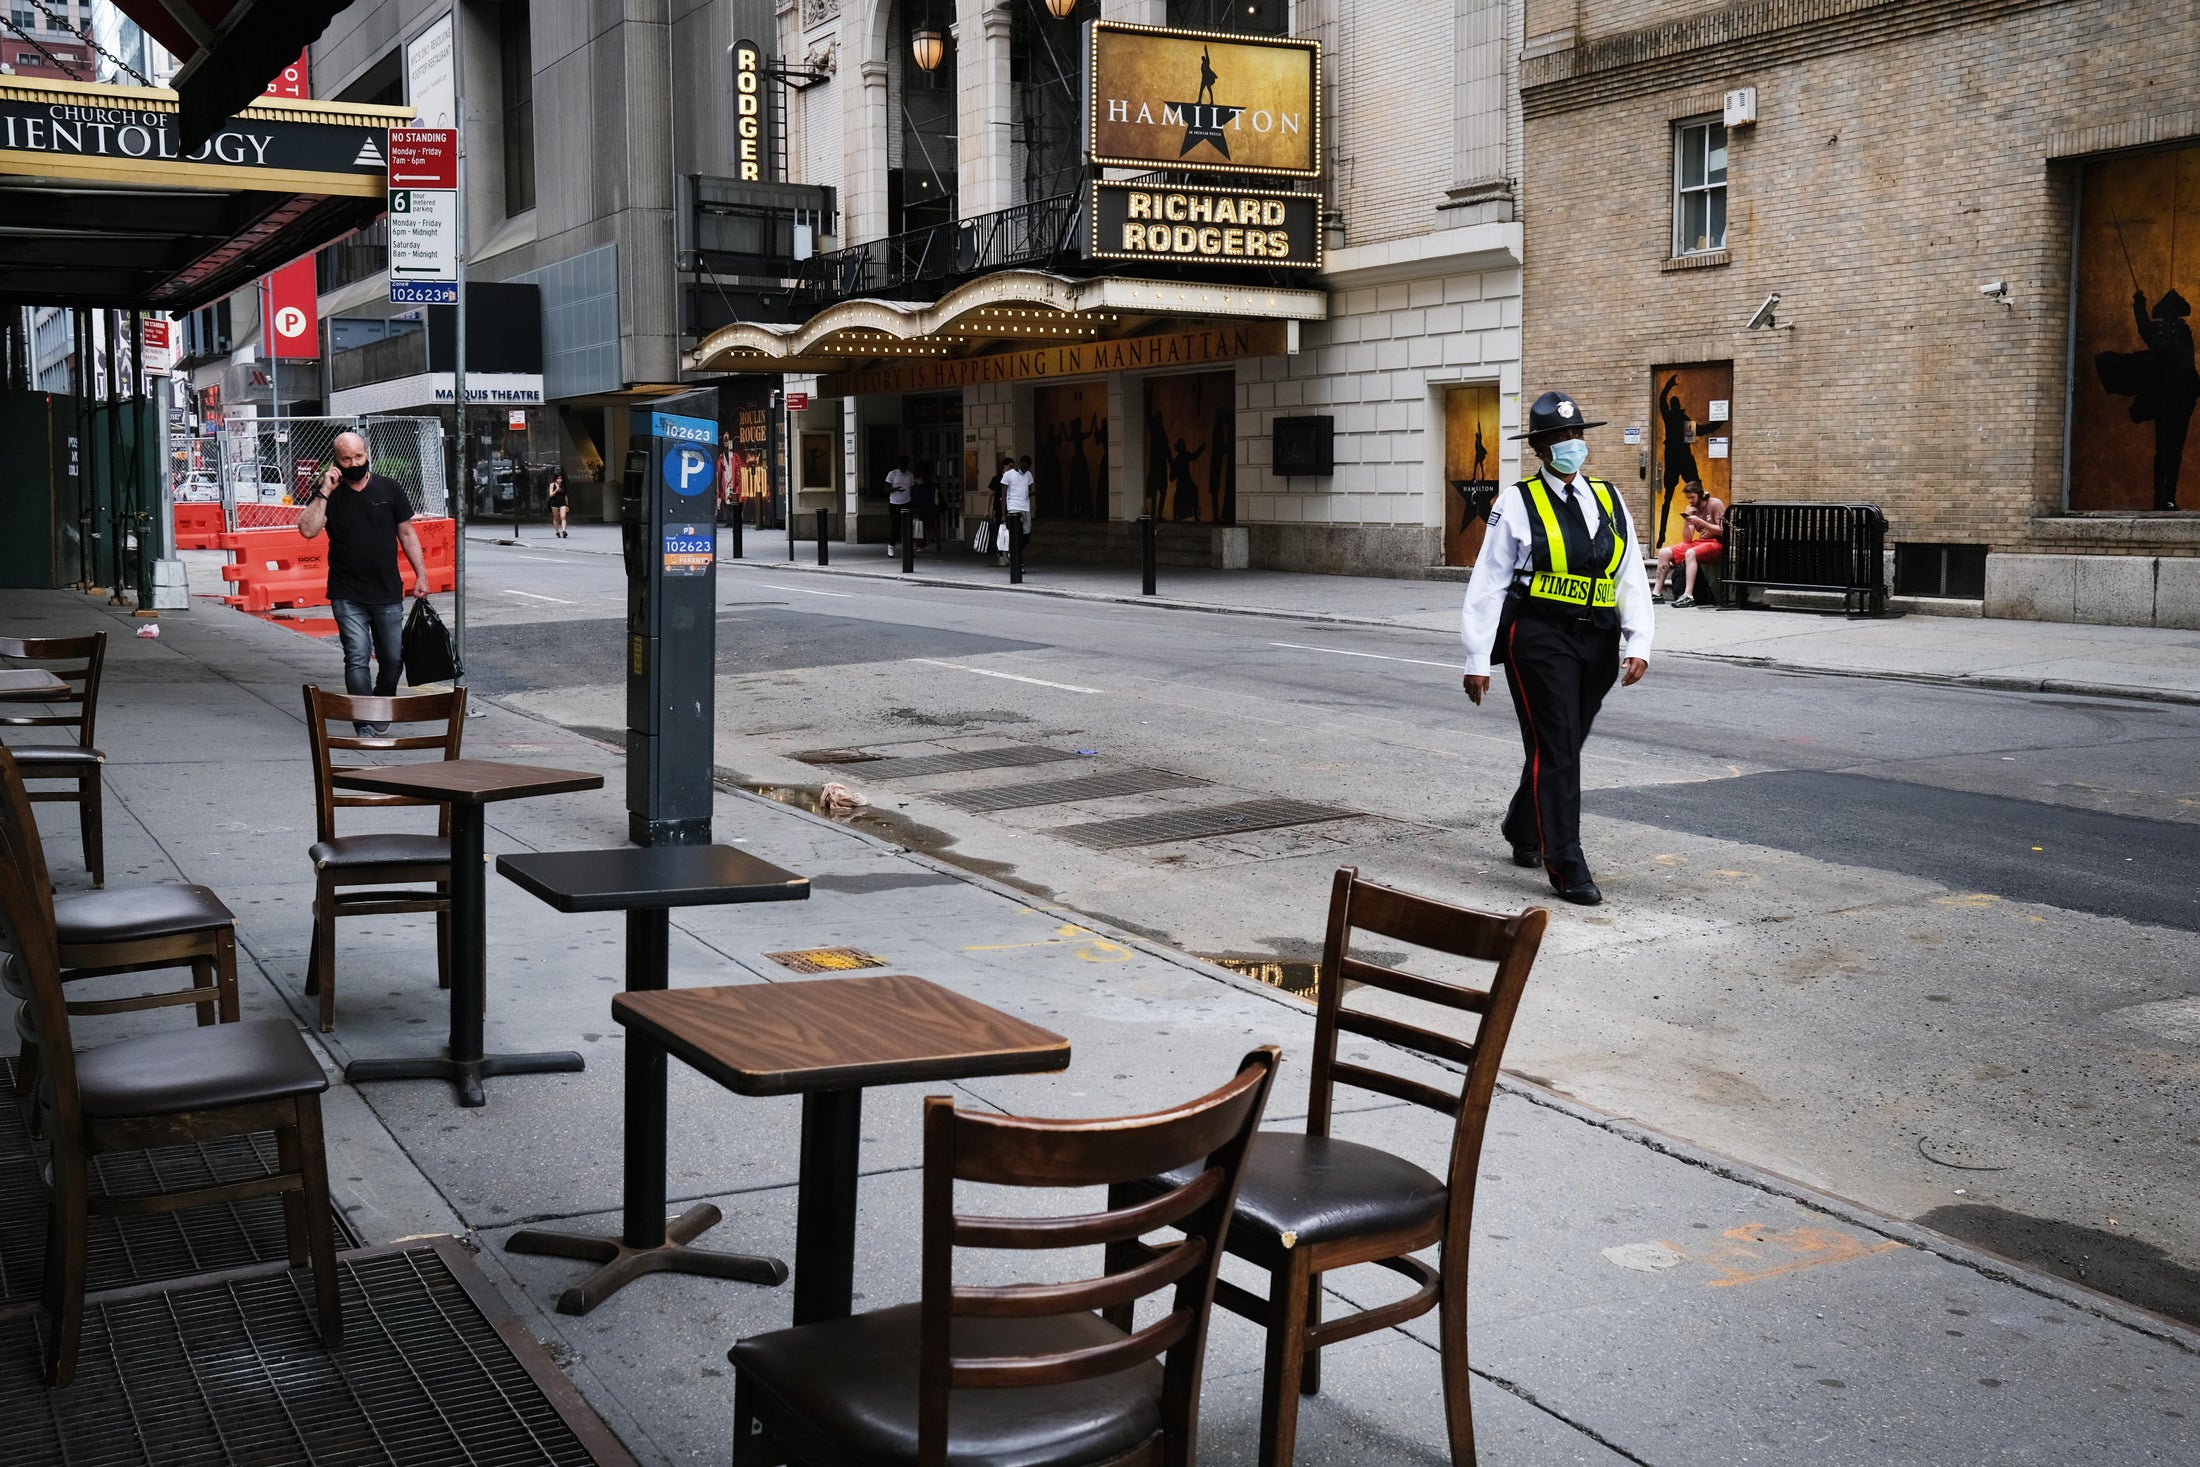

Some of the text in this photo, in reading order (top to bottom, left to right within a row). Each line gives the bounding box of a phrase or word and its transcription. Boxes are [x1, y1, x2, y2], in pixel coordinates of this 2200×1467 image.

[50, 106, 168, 127] CHURCH OF
[1107, 99, 1299, 135] HAMILTON
[391, 132, 447, 143] NO STANDING
[392, 147, 416, 156] Monday
[422, 147, 442, 157] Friday
[411, 157, 426, 165] 6pm
[394, 192, 406, 211] 6
[1128, 192, 1286, 226] RICHARD
[392, 219, 416, 227] Monday
[392, 228, 406, 236] 6pm
[412, 228, 438, 237] Midnight
[1122, 223, 1289, 258] RODGERS
[393, 241, 420, 249] Saturday
[393, 250, 406, 258] 8am
[412, 250, 438, 259] Midnight
[392, 289, 441, 301] 102623
[285, 313, 299, 332] P
[835, 328, 1249, 394] HISTORY IS HAPPENING IN MANHATTAN
[435, 389, 540, 401] MAQUIS THEATRE
[739, 409, 766, 425] MOULIN
[666, 425, 710, 441] 102623
[739, 425, 767, 443] ROUGE
[68, 436, 78, 448] POS
[681, 450, 705, 488] P
[666, 541, 711, 552] 102623
[1539, 574, 1589, 601] TIMES
